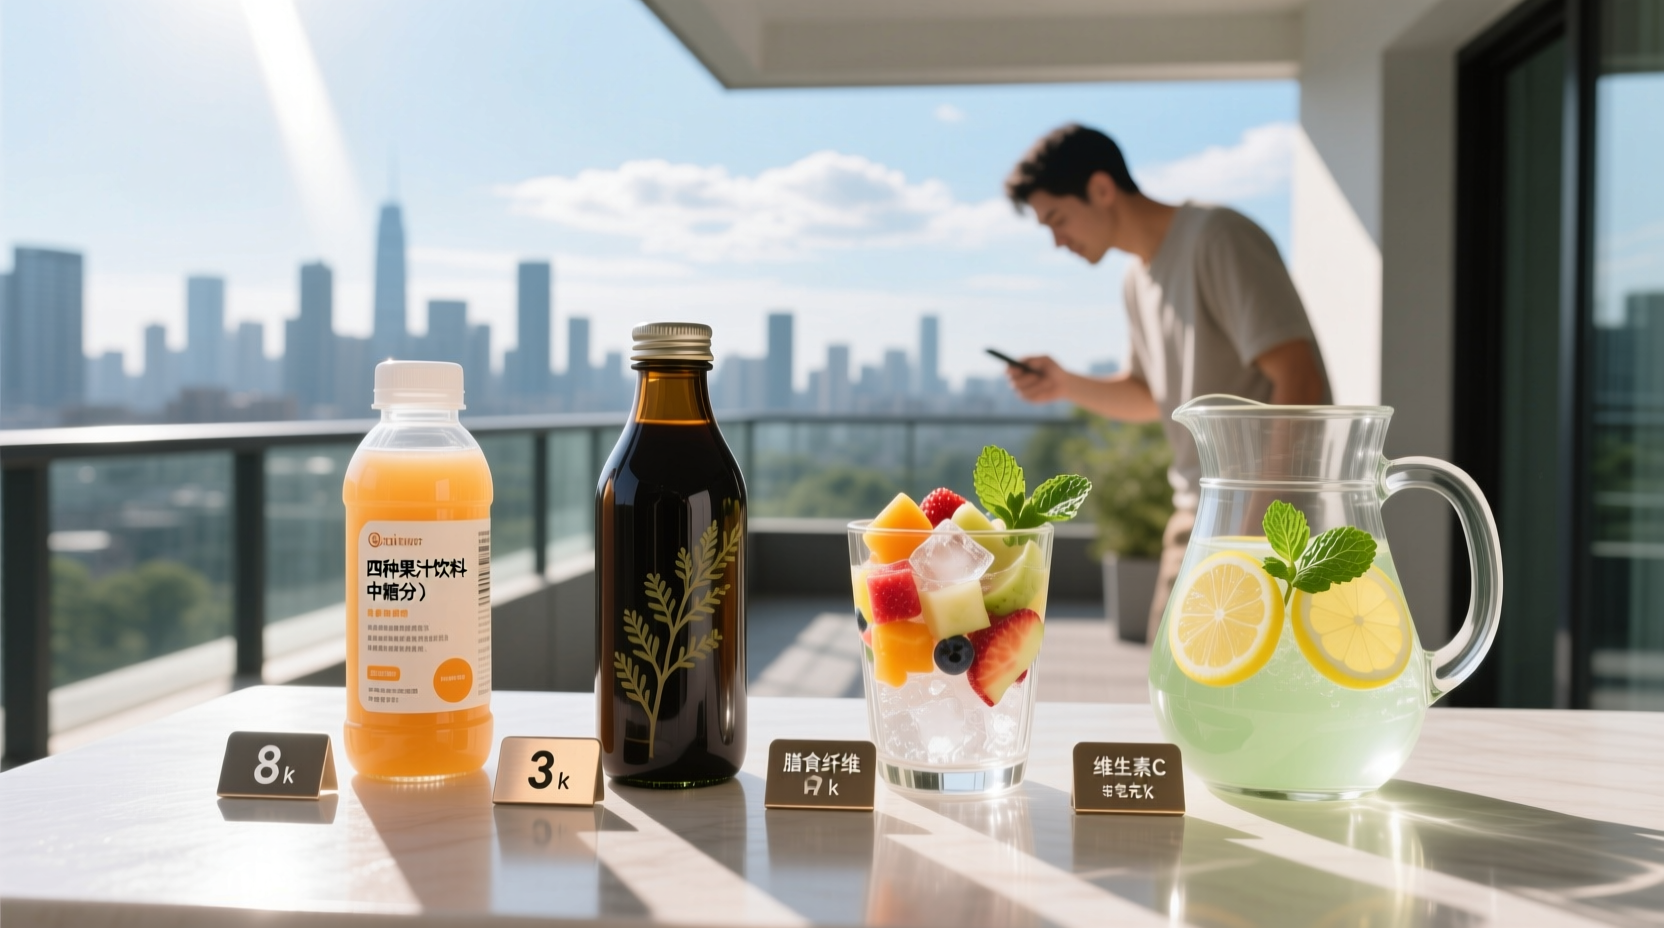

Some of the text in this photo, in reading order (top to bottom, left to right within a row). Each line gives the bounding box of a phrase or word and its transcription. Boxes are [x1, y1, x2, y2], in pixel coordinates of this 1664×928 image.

[367, 558, 468, 579] 四种果汁饮料
[1093, 755, 1166, 777] 维生素C
